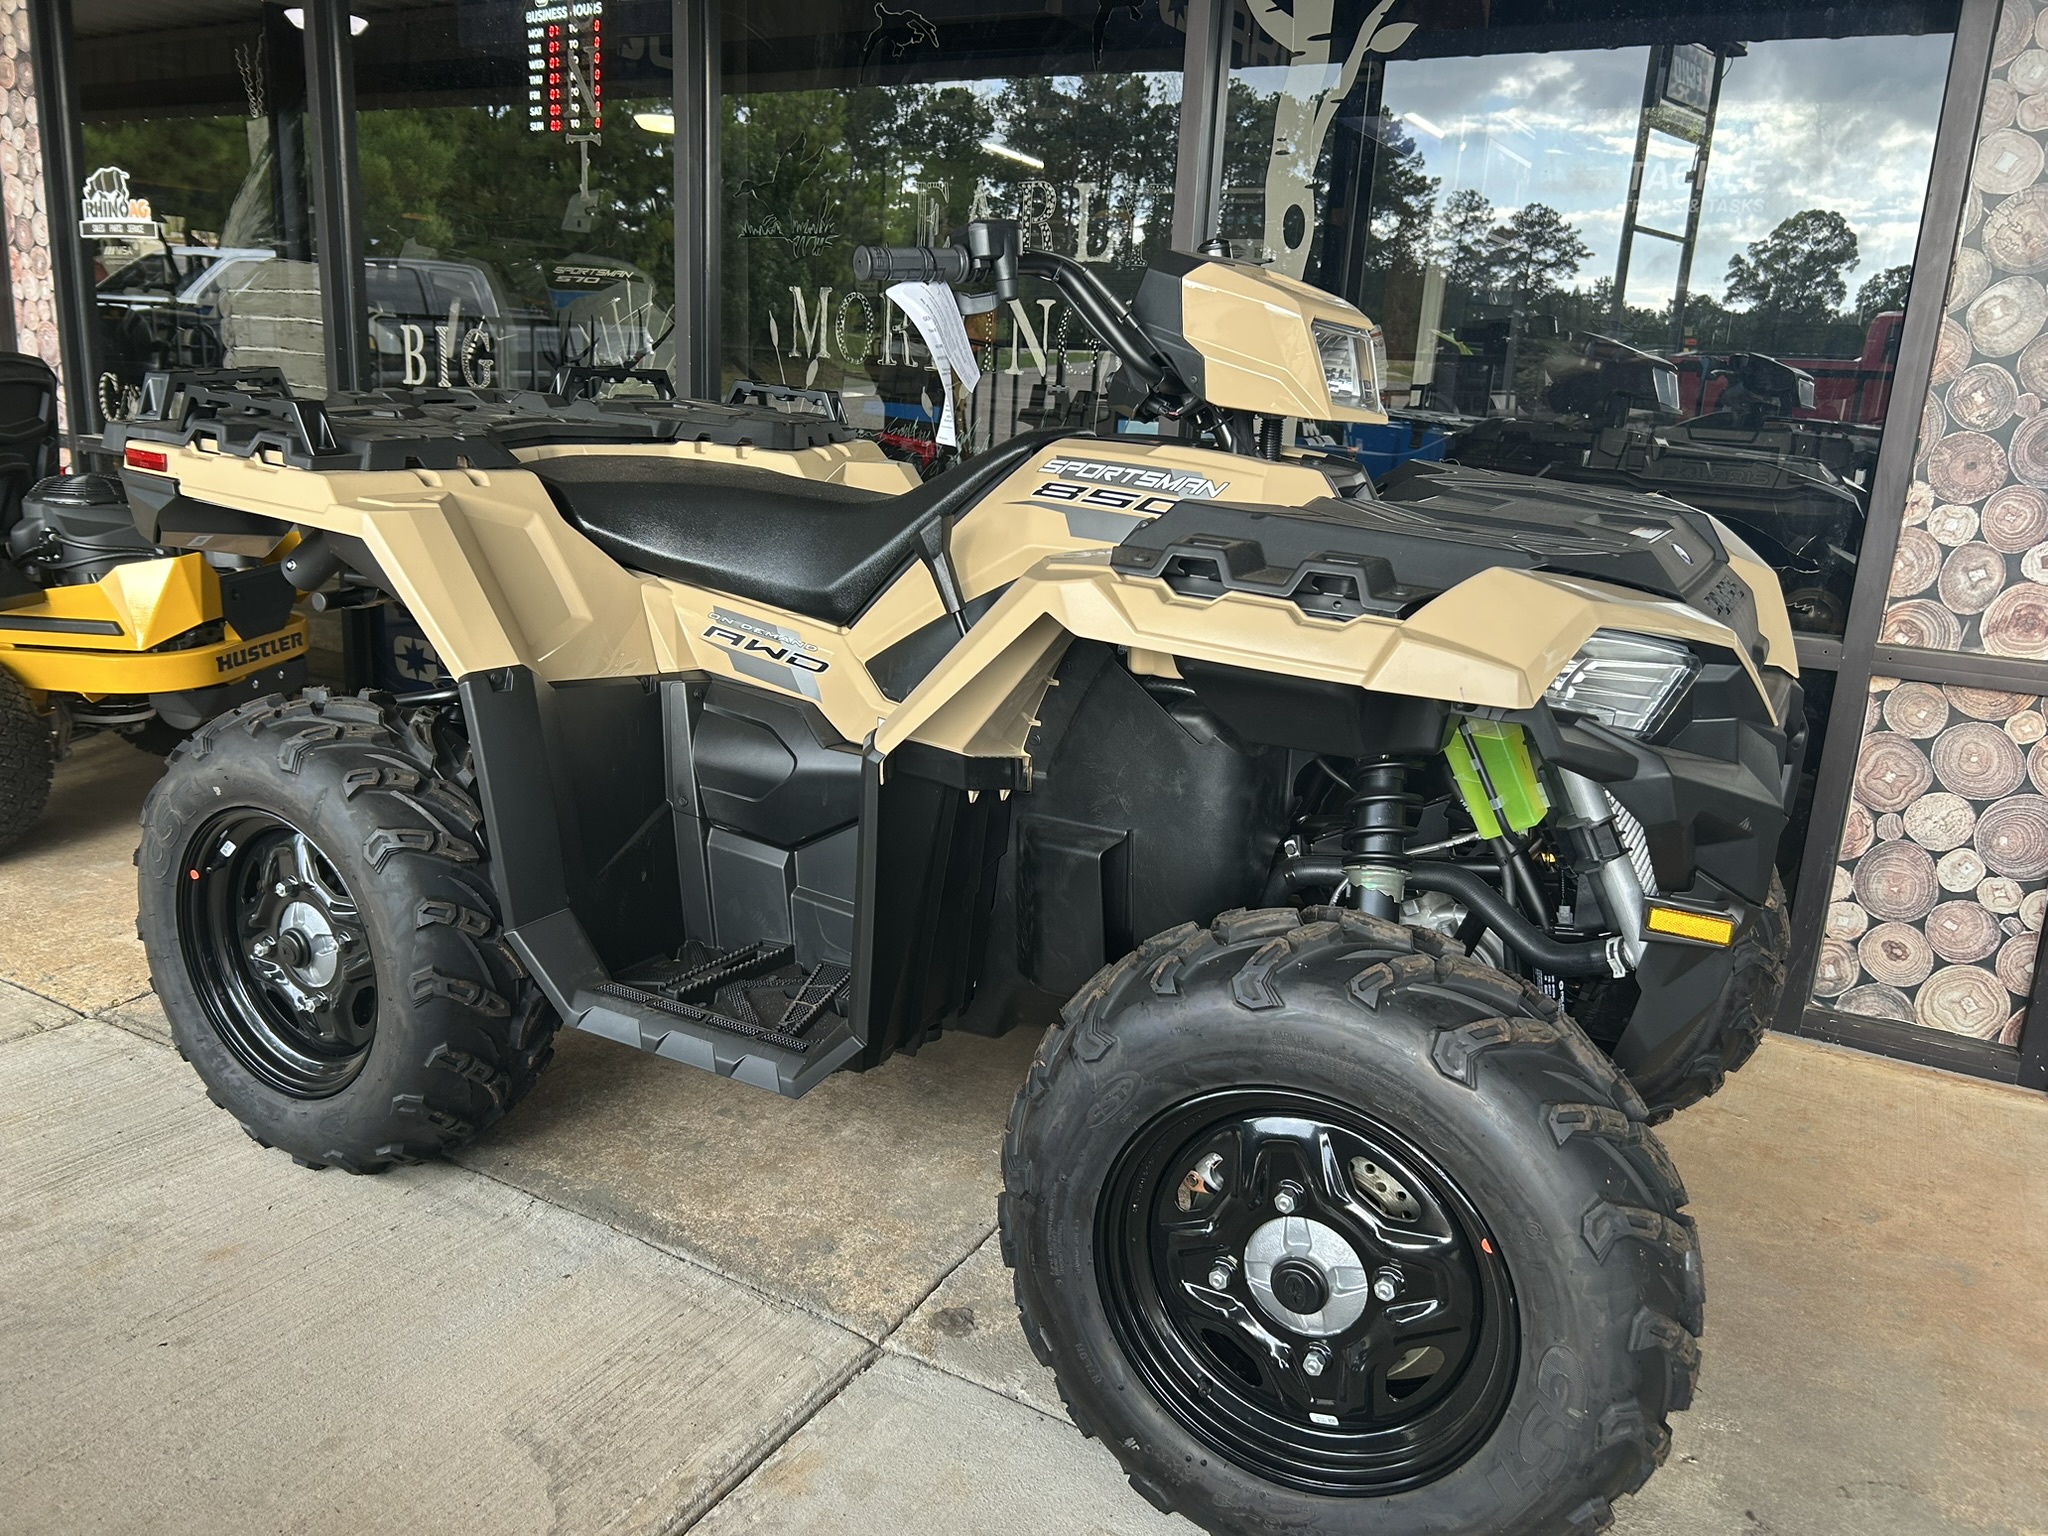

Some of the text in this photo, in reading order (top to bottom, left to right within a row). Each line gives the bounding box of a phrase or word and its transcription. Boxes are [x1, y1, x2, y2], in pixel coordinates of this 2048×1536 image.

[526, 6, 568, 24] BUSINESS
[527, 27, 545, 39] MON
[528, 43, 542, 55] TUE
[568, 39, 579, 50] TO
[528, 59, 546, 71] WED
[528, 74, 544, 86] THU
[529, 105, 544, 117] SAT
[529, 121, 545, 132] SUN
[570, 118, 581, 129] TO
[1628, 159, 1772, 191] TACKLE
[85, 199, 150, 218] RHINOAG
[1688, 199, 1700, 214] &
[1708, 198, 1766, 213] TASKS
[91, 223, 106, 233] SALES
[126, 223, 145, 234] SERVICE
[553, 266, 634, 279] SPORTSMAN
[555, 275, 601, 285] 570
[400, 324, 495, 389] BIG
[1037, 458, 1231, 499] SPORTSMAN
[1030, 481, 1182, 520] 850
[707, 611, 819, 652] ON DEMAND
[215, 631, 304, 673] HUSTLER
[701, 624, 832, 676] AWD
